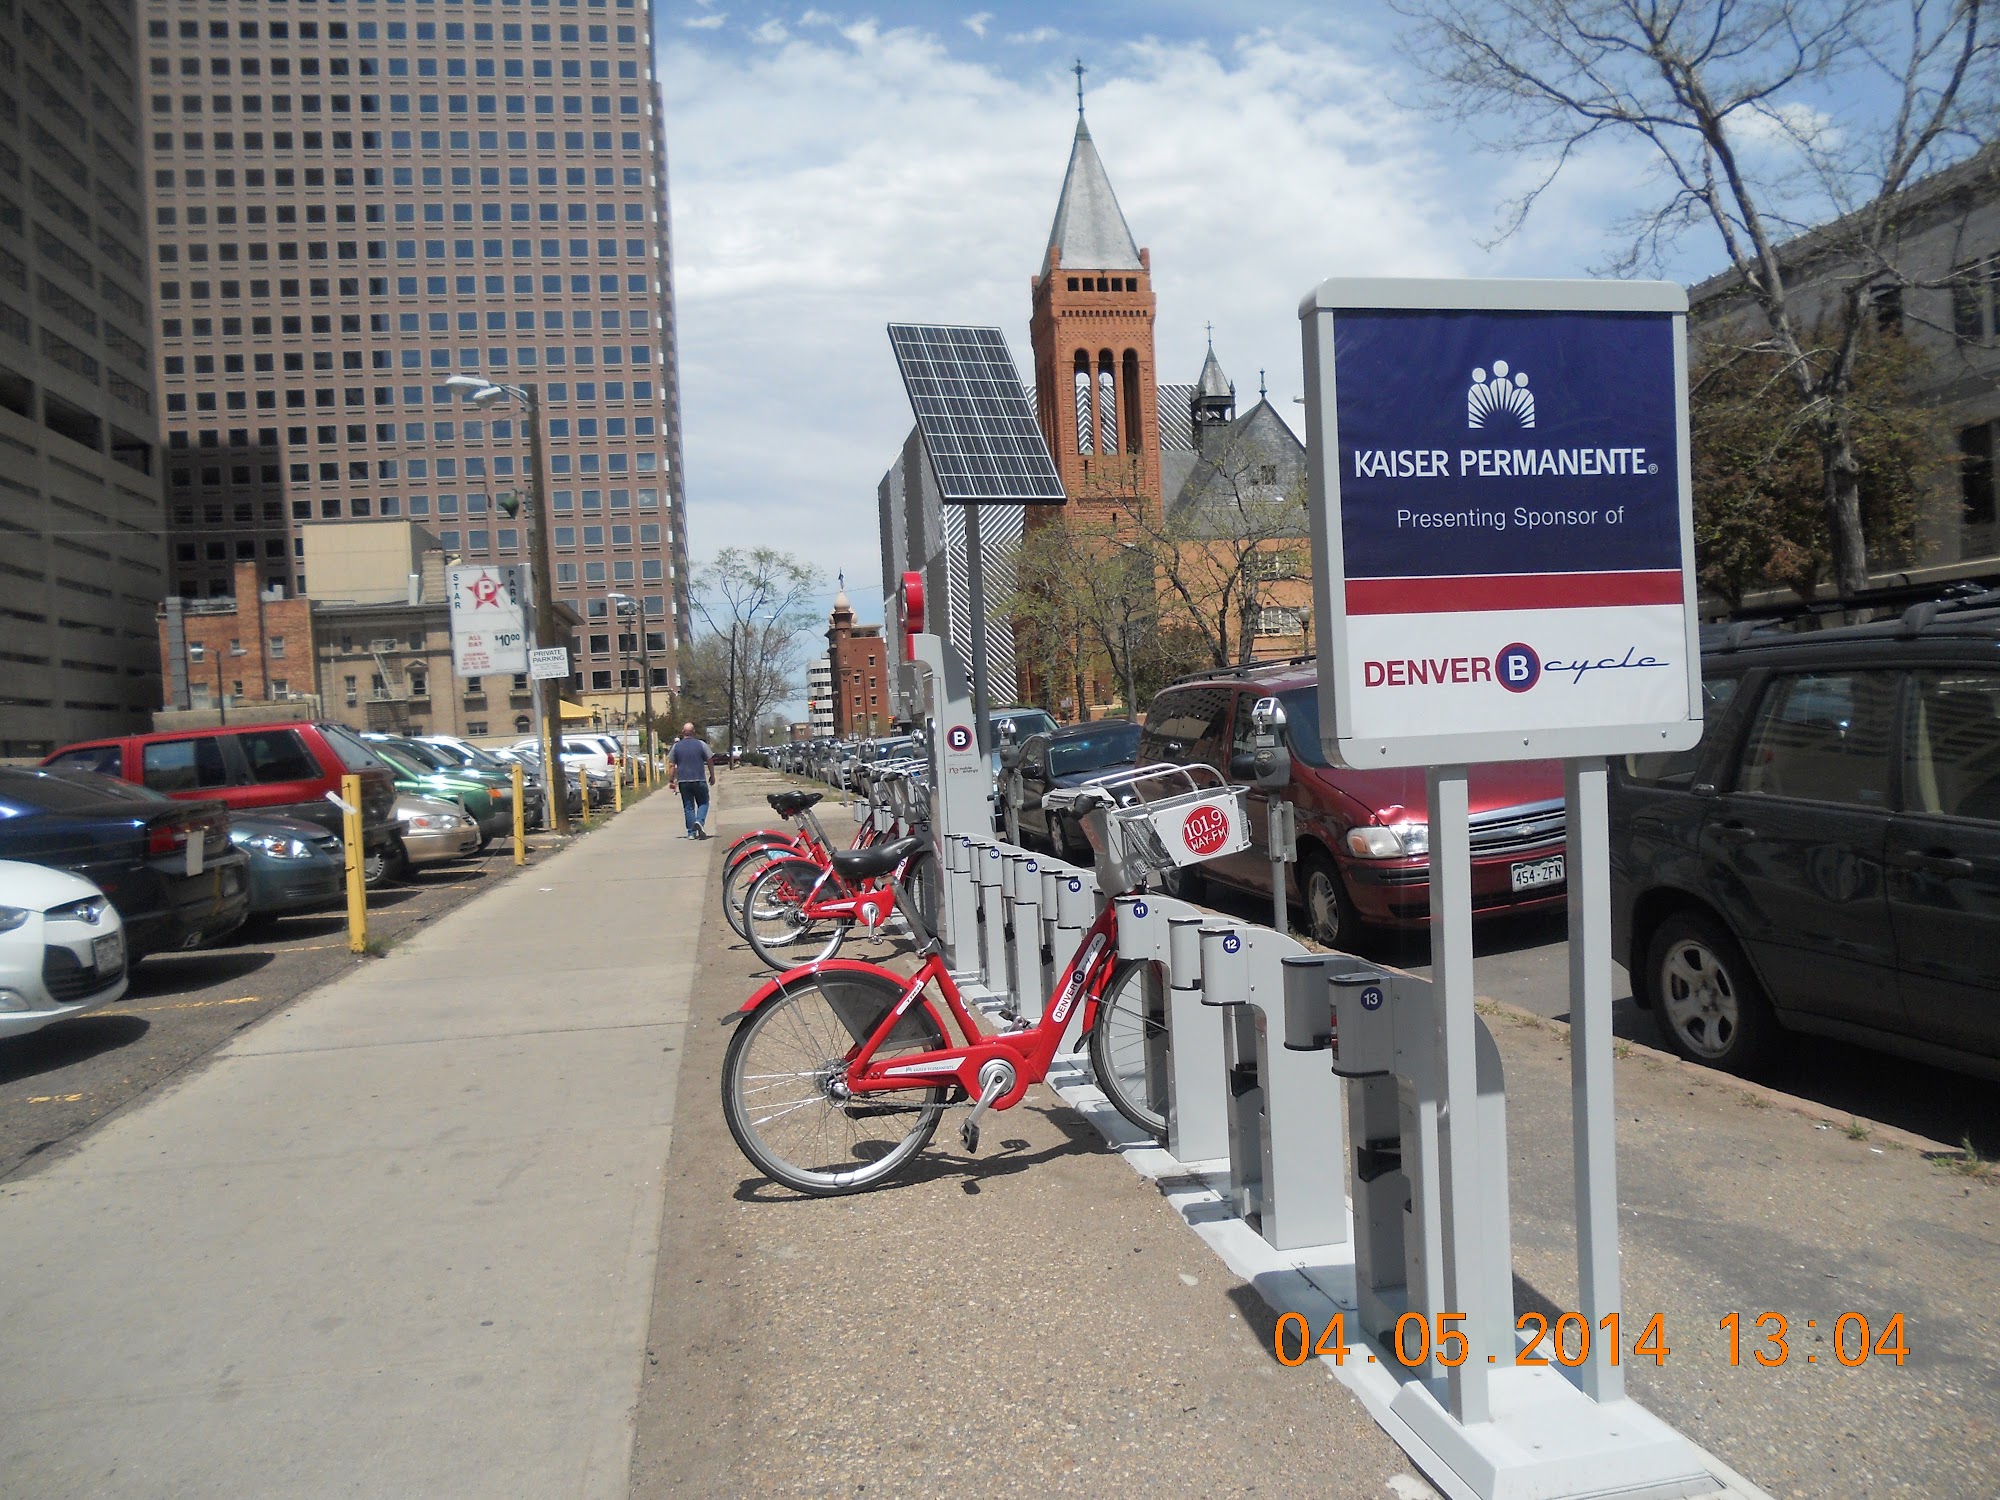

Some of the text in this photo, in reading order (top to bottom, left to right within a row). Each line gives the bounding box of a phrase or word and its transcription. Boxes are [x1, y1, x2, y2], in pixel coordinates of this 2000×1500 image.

[1355, 450, 1449, 478] KAISER
[1397, 506, 1625, 531] Presenting Sponsor of
[453, 574, 461, 609] STAR
[478, 580, 491, 600] P
[508, 570, 517, 605] PARK
[534, 649, 563, 657] PRIVATE
[1364, 656, 1491, 688] DENVER
[1184, 810, 1223, 840] 101.9
[1191, 827, 1227, 850] WAY-FM
[1070, 882, 1079, 890] 10
[1136, 906, 1145, 915] 11
[1225, 939, 1237, 949] 12
[1055, 983, 1077, 1018] DENVER
[1364, 993, 1378, 1005] 13
